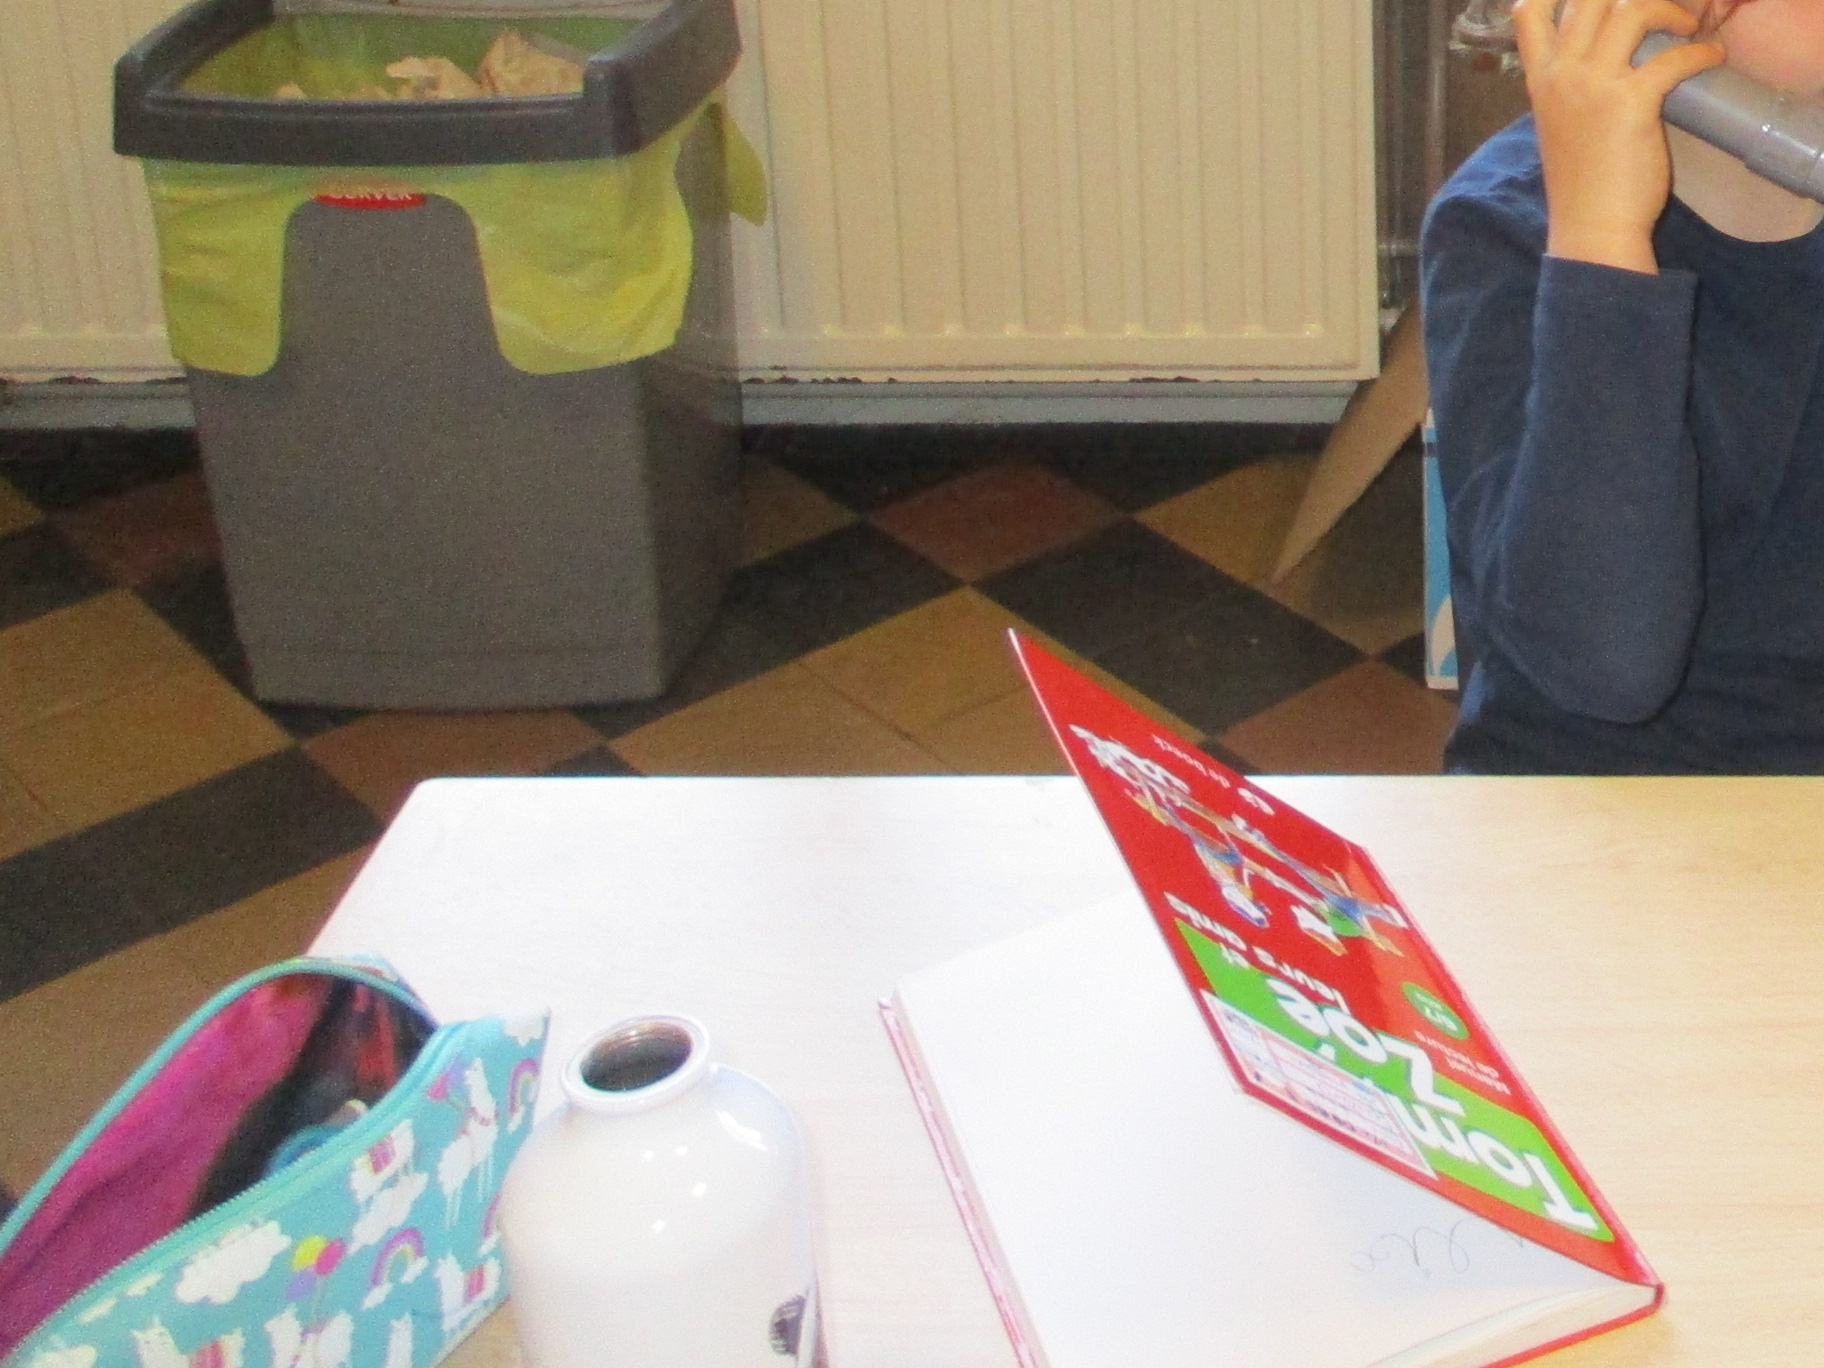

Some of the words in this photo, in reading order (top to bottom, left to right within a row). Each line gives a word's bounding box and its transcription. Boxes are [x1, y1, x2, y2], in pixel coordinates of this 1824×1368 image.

[1163, 891, 1248, 952] amis
[1219, 942, 1250, 970] et
[1252, 945, 1350, 1016] leurs
[1265, 977, 1467, 1117] Zoé
[1364, 1076, 1599, 1231] Tom
